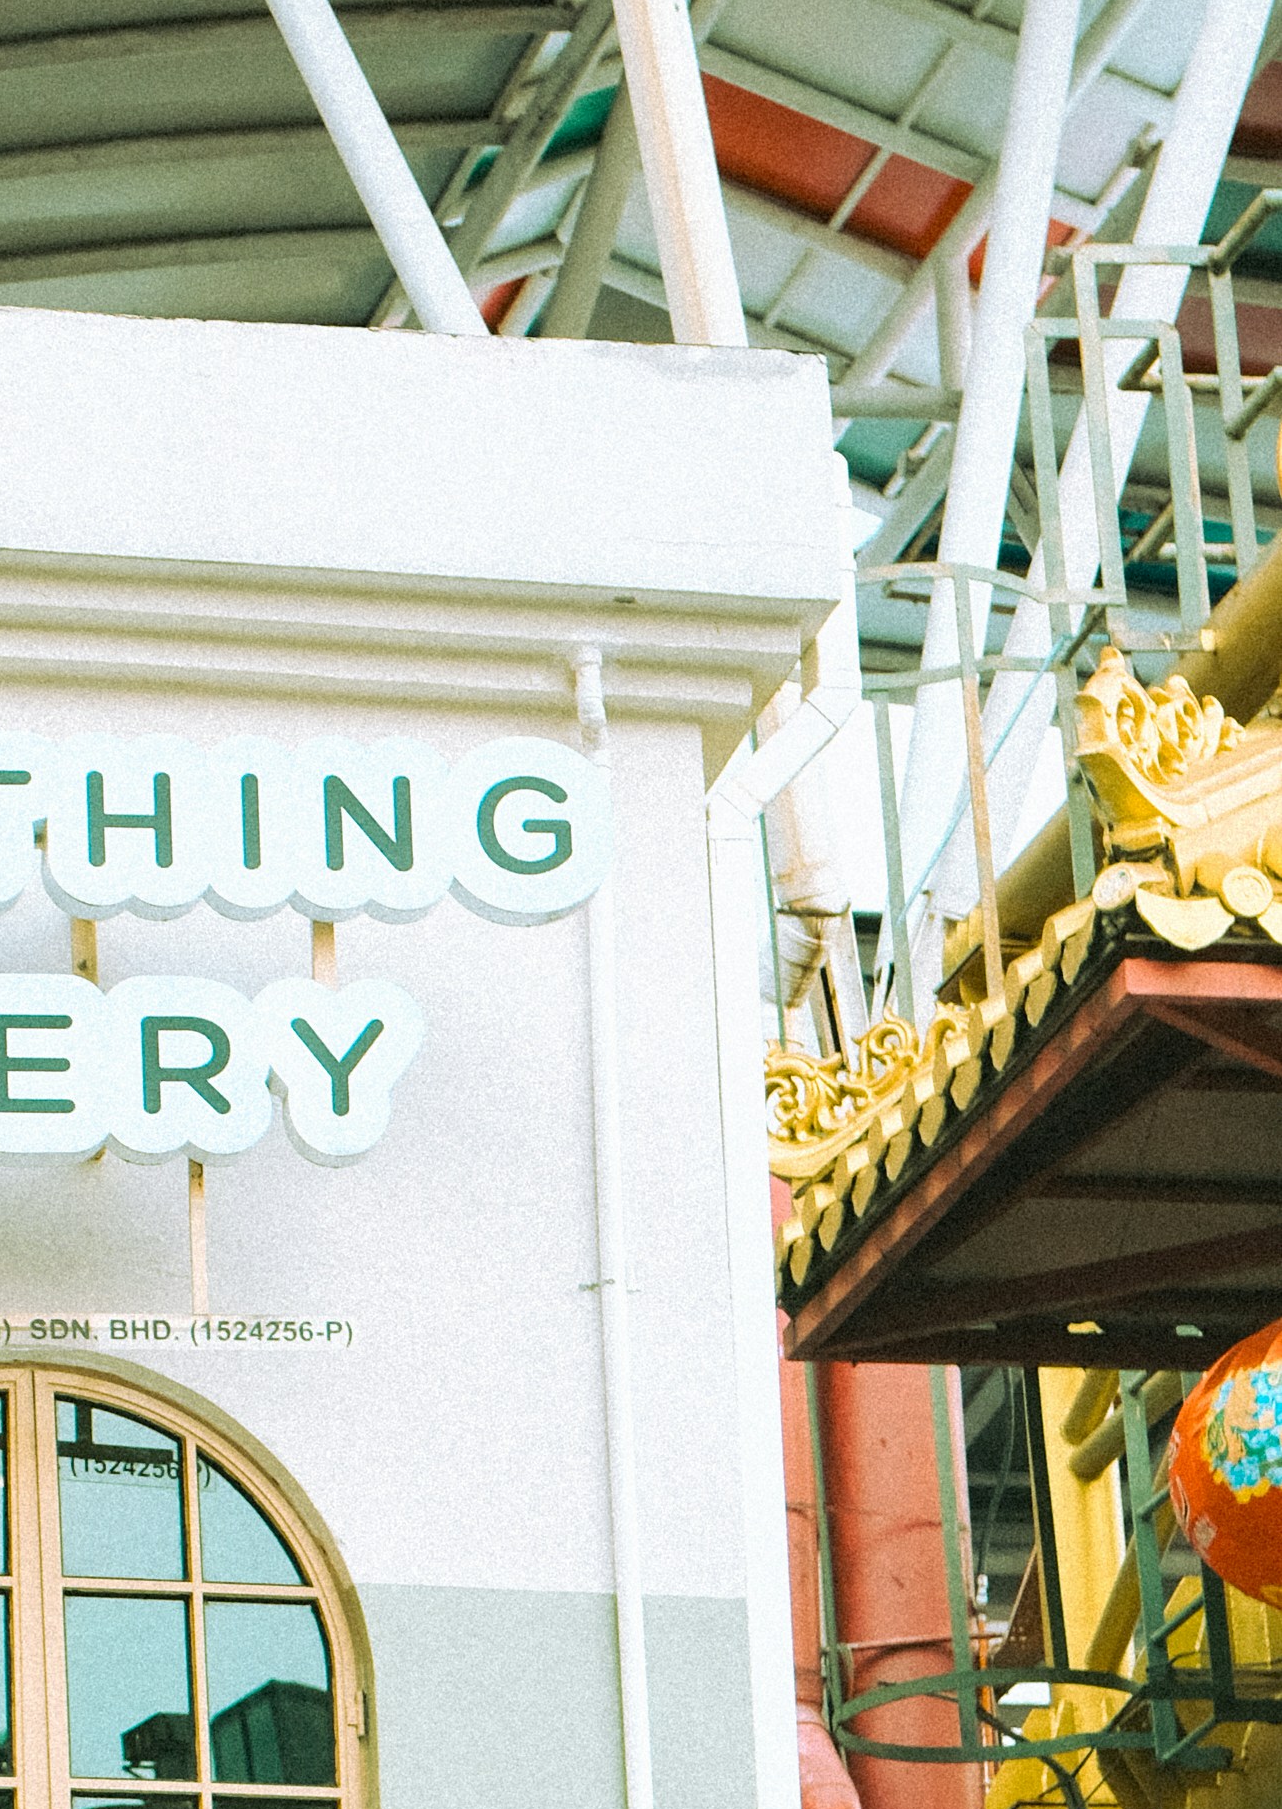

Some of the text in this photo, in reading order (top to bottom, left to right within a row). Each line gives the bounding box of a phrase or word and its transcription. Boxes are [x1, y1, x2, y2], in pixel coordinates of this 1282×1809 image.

[30, 1320, 99, 1341] SDN.
[109, 1321, 179, 1342] BHD.
[190, 1320, 354, 1348] (1524256-P)
